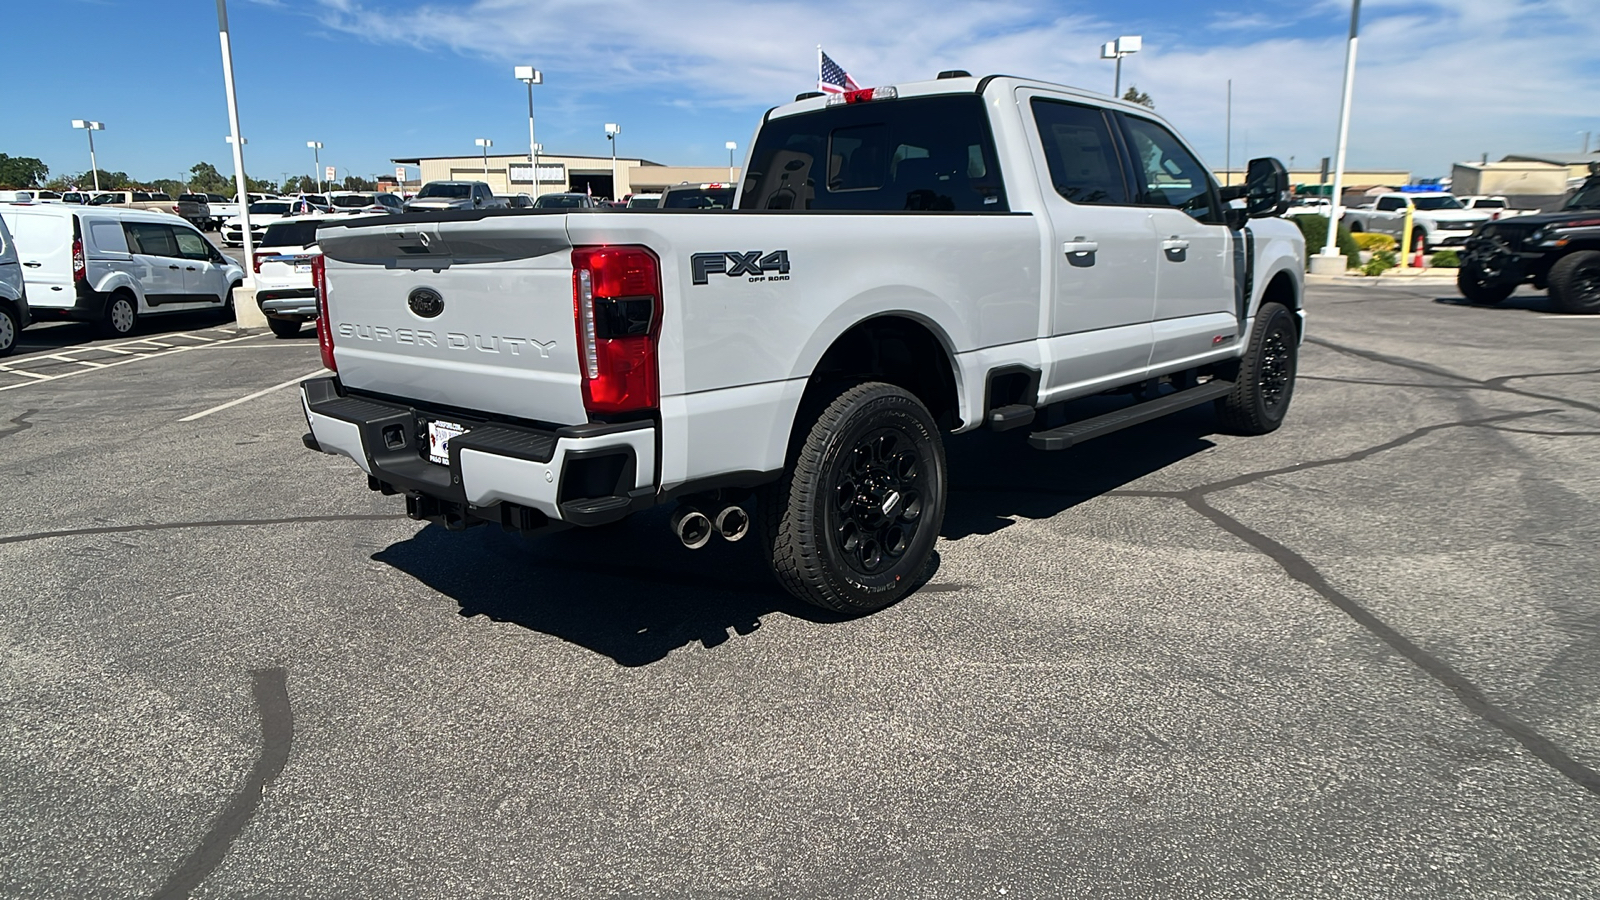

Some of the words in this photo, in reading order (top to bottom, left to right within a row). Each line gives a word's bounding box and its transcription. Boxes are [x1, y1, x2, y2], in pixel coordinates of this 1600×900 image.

[690, 250, 790, 285] FX4
[338, 322, 438, 348] SUPER
[446, 332, 557, 358] DUTY
